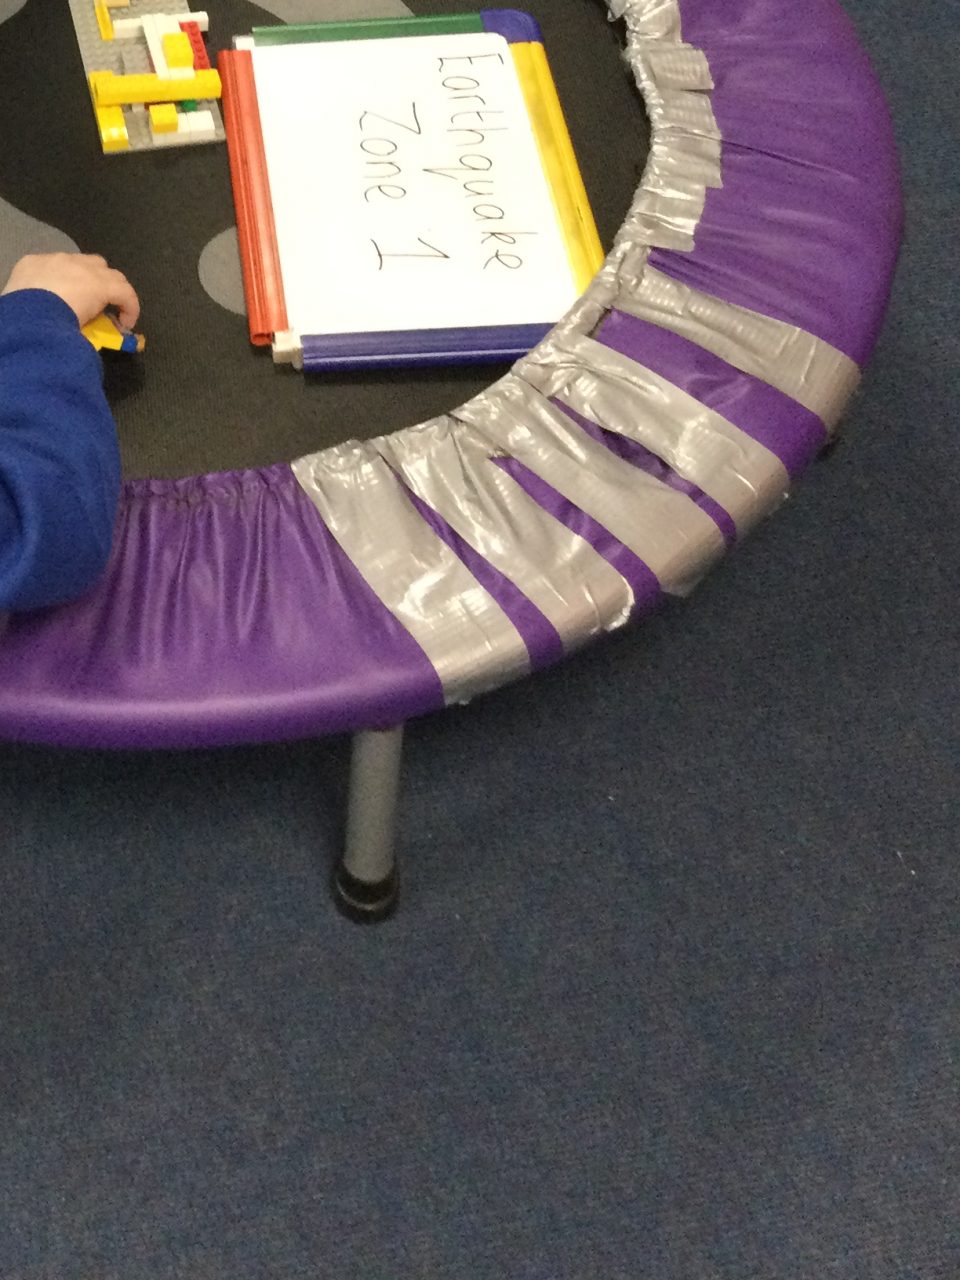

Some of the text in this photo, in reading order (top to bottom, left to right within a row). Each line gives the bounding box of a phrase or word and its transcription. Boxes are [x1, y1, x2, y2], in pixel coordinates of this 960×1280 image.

[359, 101, 450, 270] Zone 1
[423, 53, 538, 270] Earthquake
